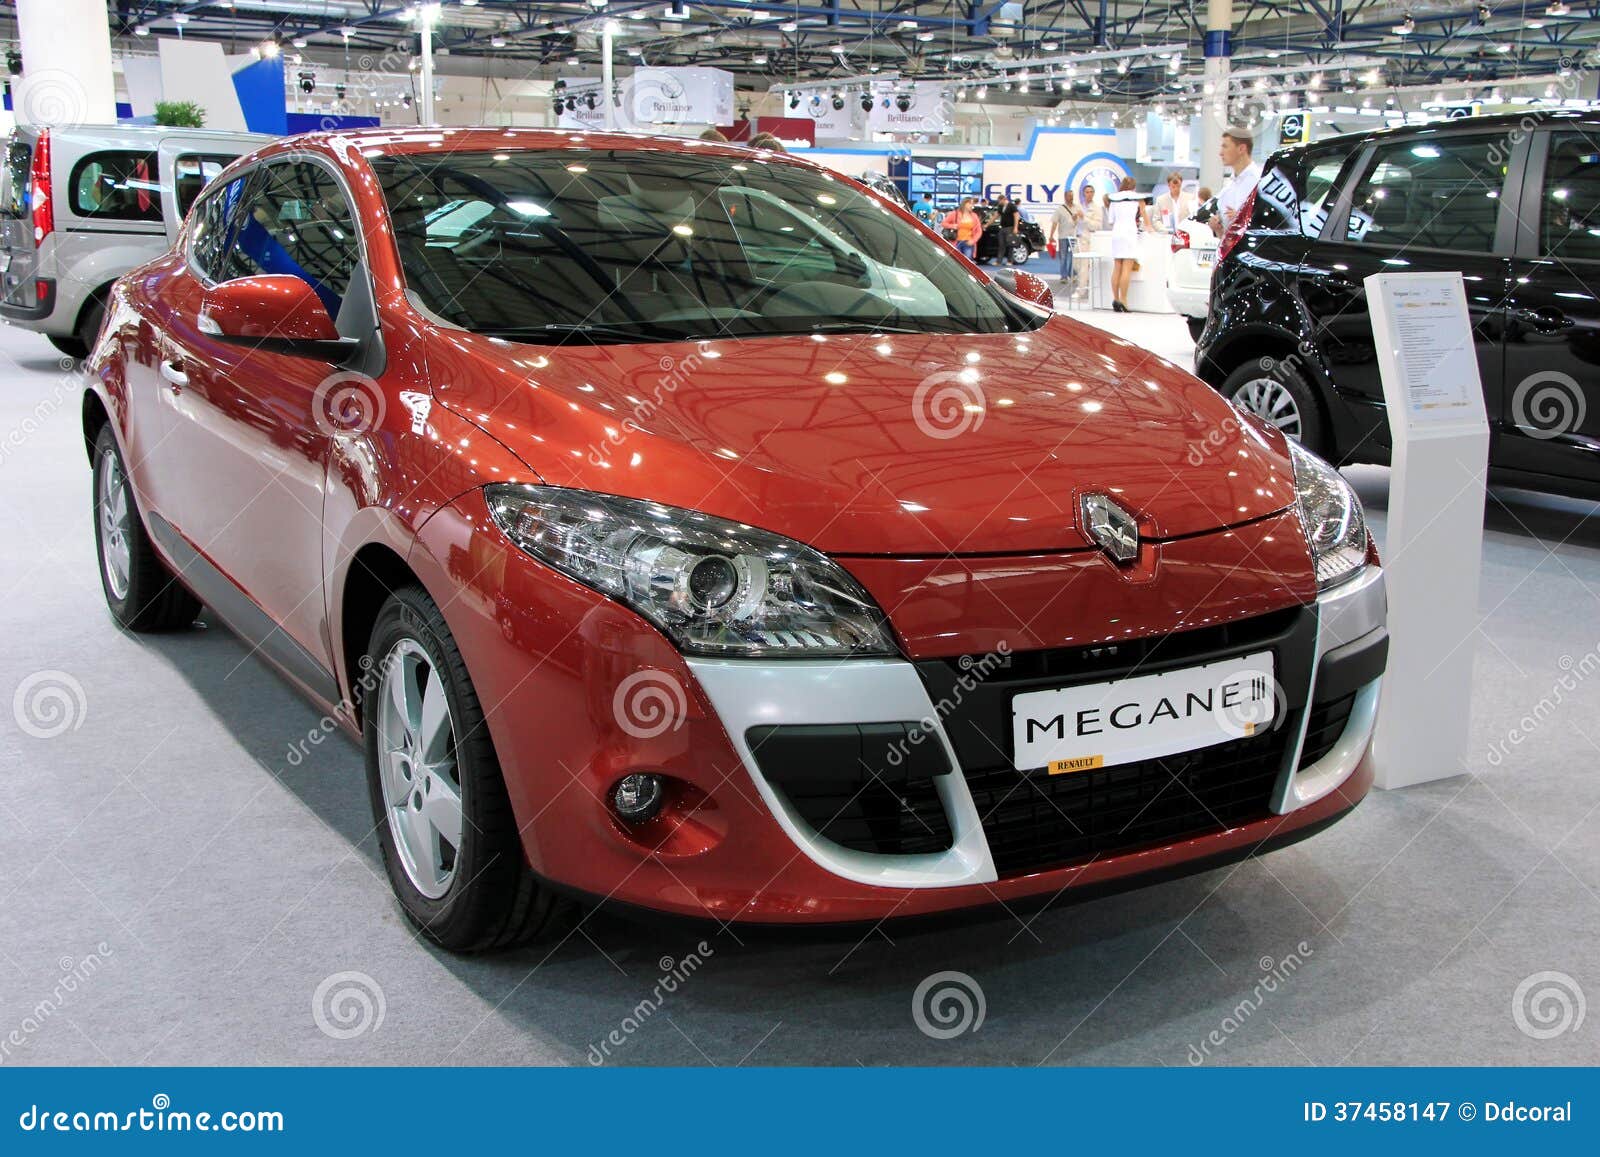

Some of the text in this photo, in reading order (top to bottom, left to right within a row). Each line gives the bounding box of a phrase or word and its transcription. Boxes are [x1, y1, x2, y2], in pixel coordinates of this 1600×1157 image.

[576, 110, 605, 121] Brillian
[985, 183, 1061, 203] EELY
[1026, 681, 1242, 744] MEGANE
[1056, 756, 1095, 771] RENAULT
